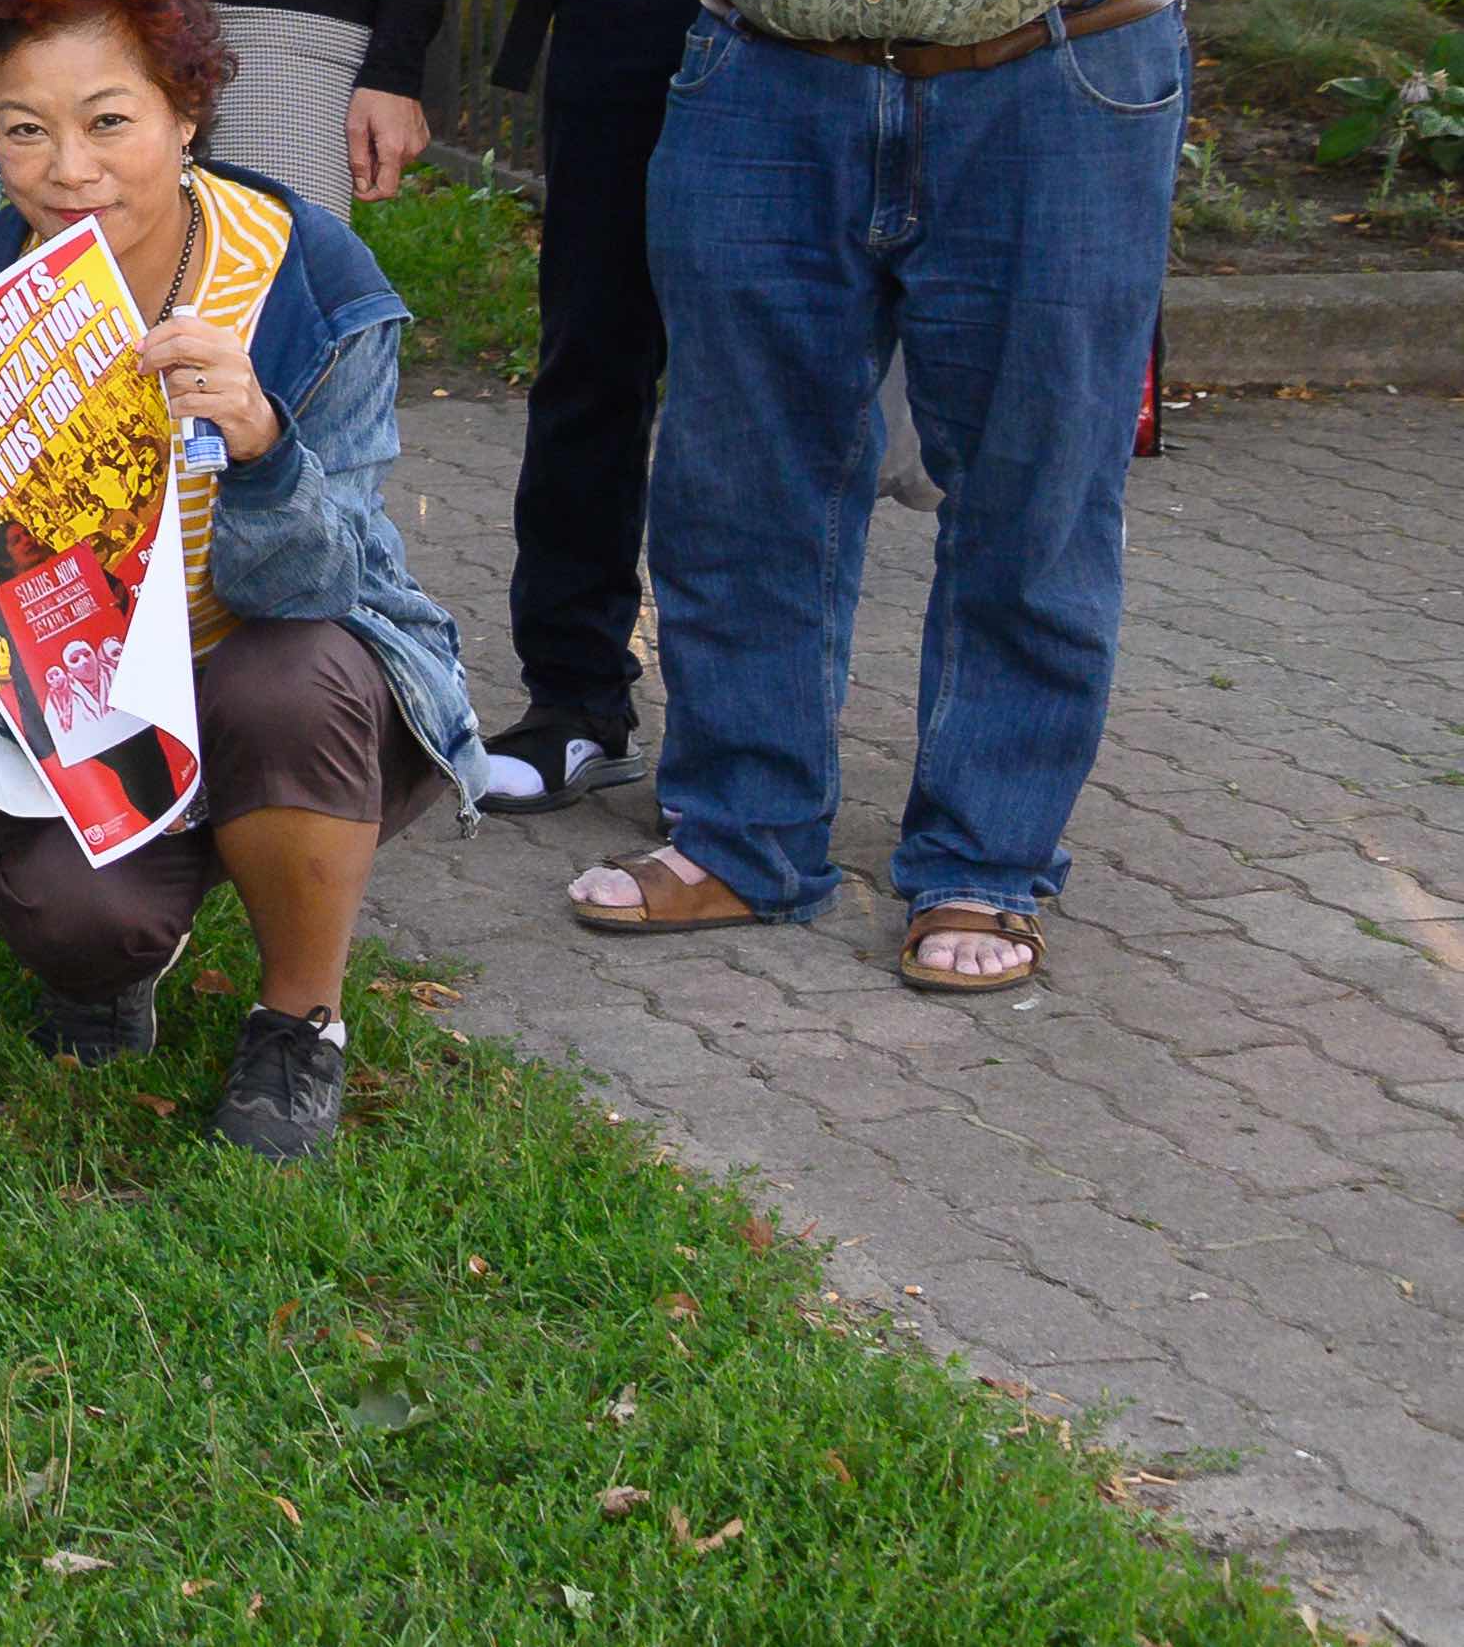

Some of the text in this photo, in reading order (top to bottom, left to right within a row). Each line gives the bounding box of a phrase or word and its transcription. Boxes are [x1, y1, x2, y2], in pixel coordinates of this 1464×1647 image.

[35, 370, 82, 443] FOR
[73, 307, 132, 397] ALL!
[14, 570, 55, 607] STATUS
[55, 557, 82, 586] NOW
